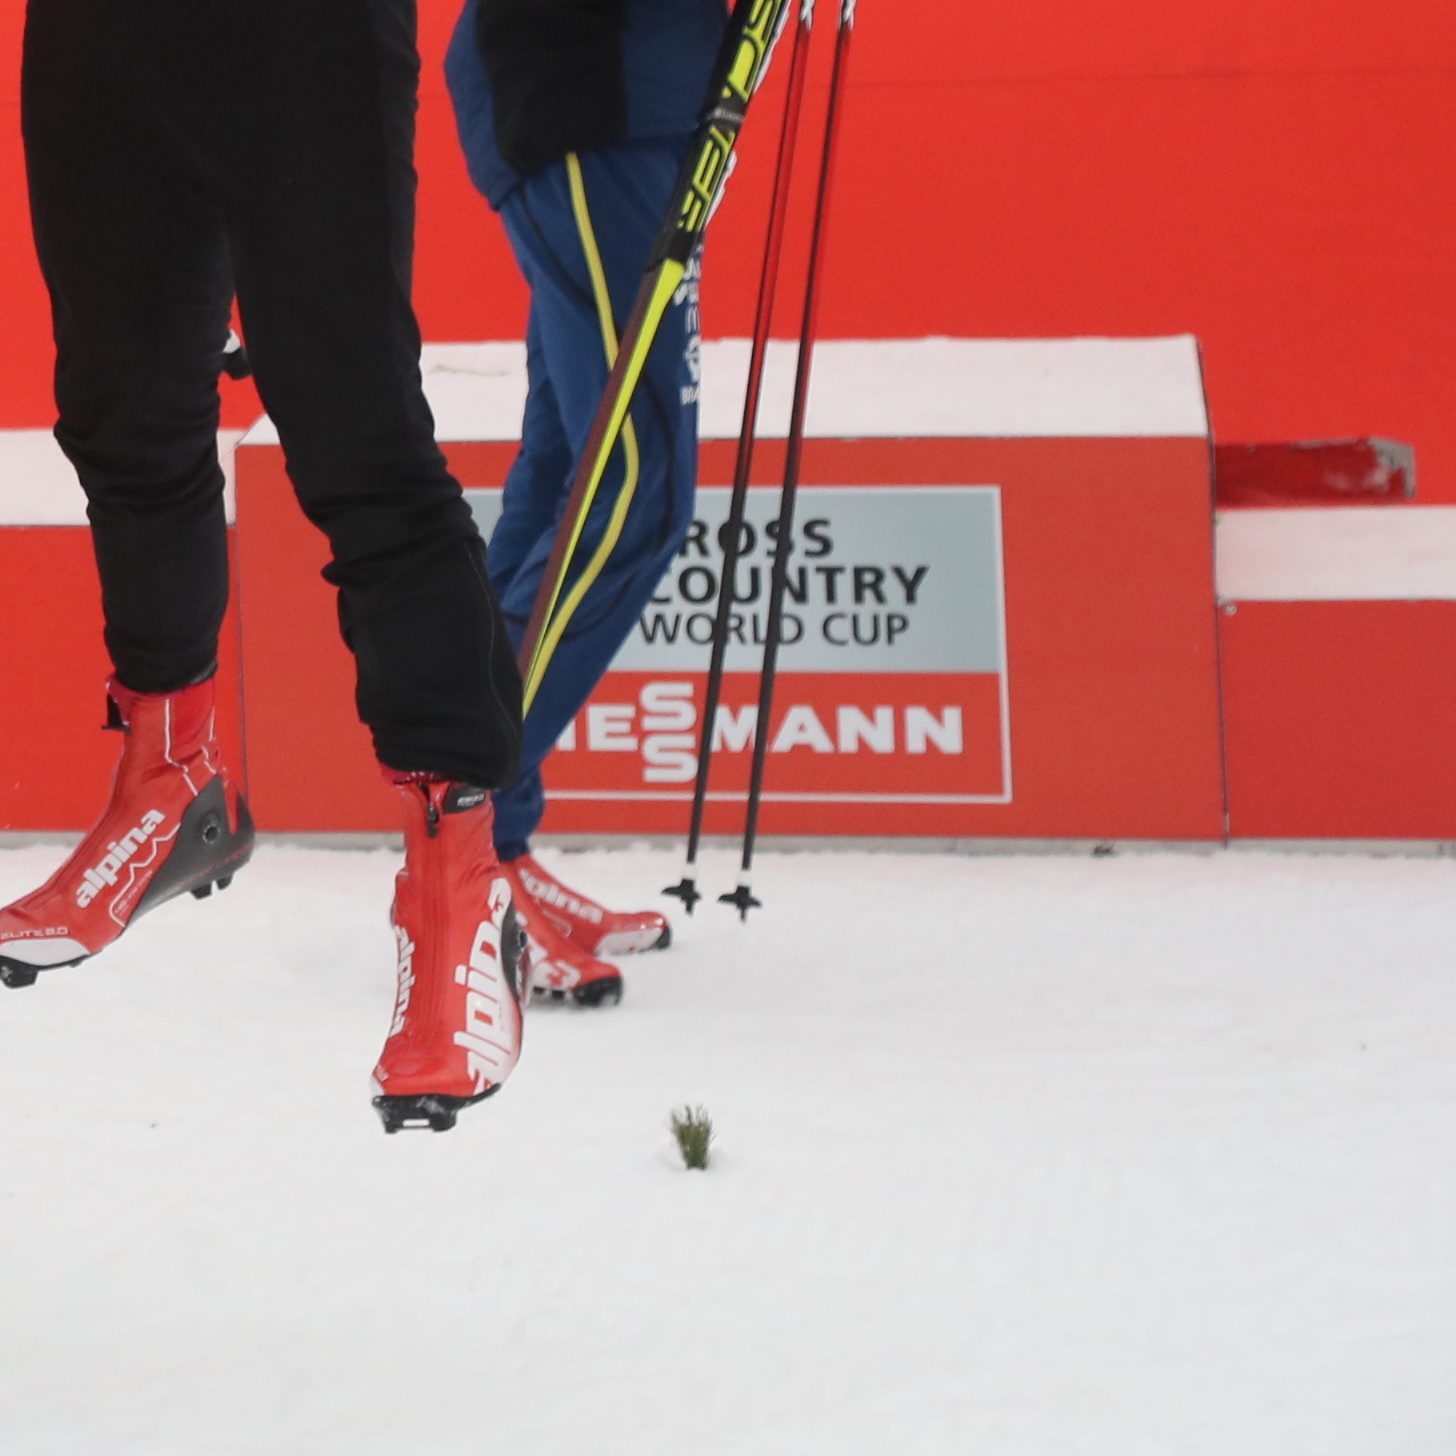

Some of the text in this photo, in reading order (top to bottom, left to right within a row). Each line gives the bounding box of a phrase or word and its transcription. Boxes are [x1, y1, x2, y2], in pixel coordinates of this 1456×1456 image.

[679, 518, 834, 560] ROSS
[651, 565, 930, 606] COUNTRY
[640, 612, 910, 646] WORLD CUP
[562, 680, 964, 784] IESSMANN
[74, 807, 166, 908] alpina
